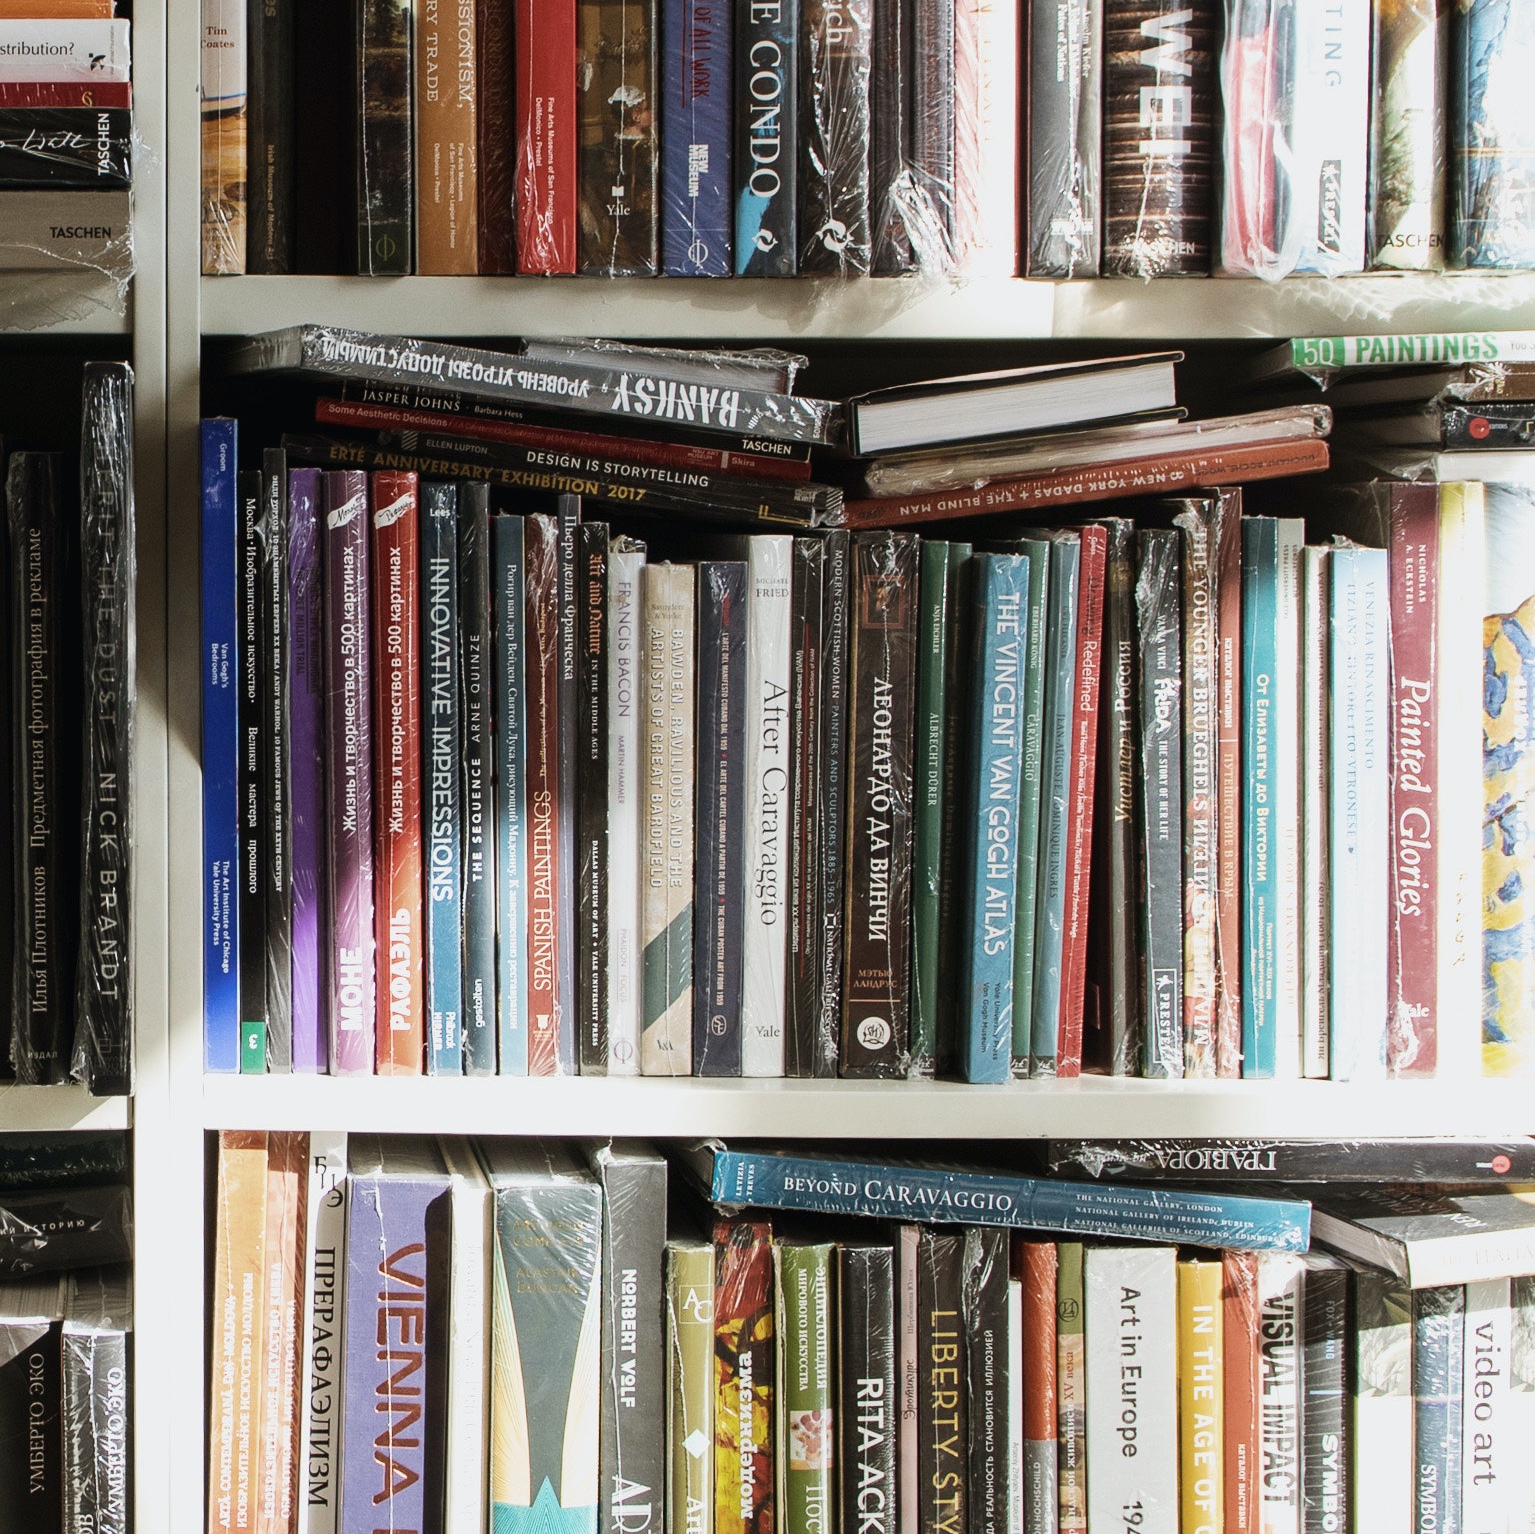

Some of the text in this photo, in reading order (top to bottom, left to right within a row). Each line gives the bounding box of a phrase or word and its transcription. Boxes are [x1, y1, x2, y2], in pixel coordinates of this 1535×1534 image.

[747, 35, 781, 199] CONDO
[610, 372, 745, 427] BANKSY
[1300, 335, 1499, 366] 50 PAINTINGS
[526, 451, 710, 488] DESIGN IS STORYTELLING
[996, 592, 1020, 634] THE
[428, 557, 452, 902] INNOVATIVE IMPRESSIONS
[993, 639, 1019, 748] VINCENT
[755, 678, 788, 927] After Caravaggio
[868, 678, 895, 942] ЛЕОНАРДО ДА ВИНЧИ
[990, 754, 1014, 800] VAN
[1400, 676, 1437, 916] Painted Glories
[98, 771, 118, 1000] NICK BRANDT
[983, 887, 1007, 957] ATLAS
[340, 947, 363, 1032] МОНЕ
[389, 907, 411, 1032] РАФАЭЛЬ
[782, 1175, 1013, 1212] BEYOND CARAVAGGIO
[1118, 1285, 1141, 1459] Art in Europe
[1192, 1305, 1213, 1334] IN
[1192, 1345, 1214, 1401] THE
[307, 1247, 337, 1508] ПРЕРАФАЭЛИЗМ
[372, 1242, 425, 1509] VIENNA
[856, 1377, 884, 1452] RITA
[929, 1309, 958, 1457] LIBERTY
[1471, 1320, 1494, 1488] video art
[738, 1350, 759, 1520] модернизма
[1192, 1411, 1215, 1466] AGE
[1192, 1478, 1215, 1515] OF
